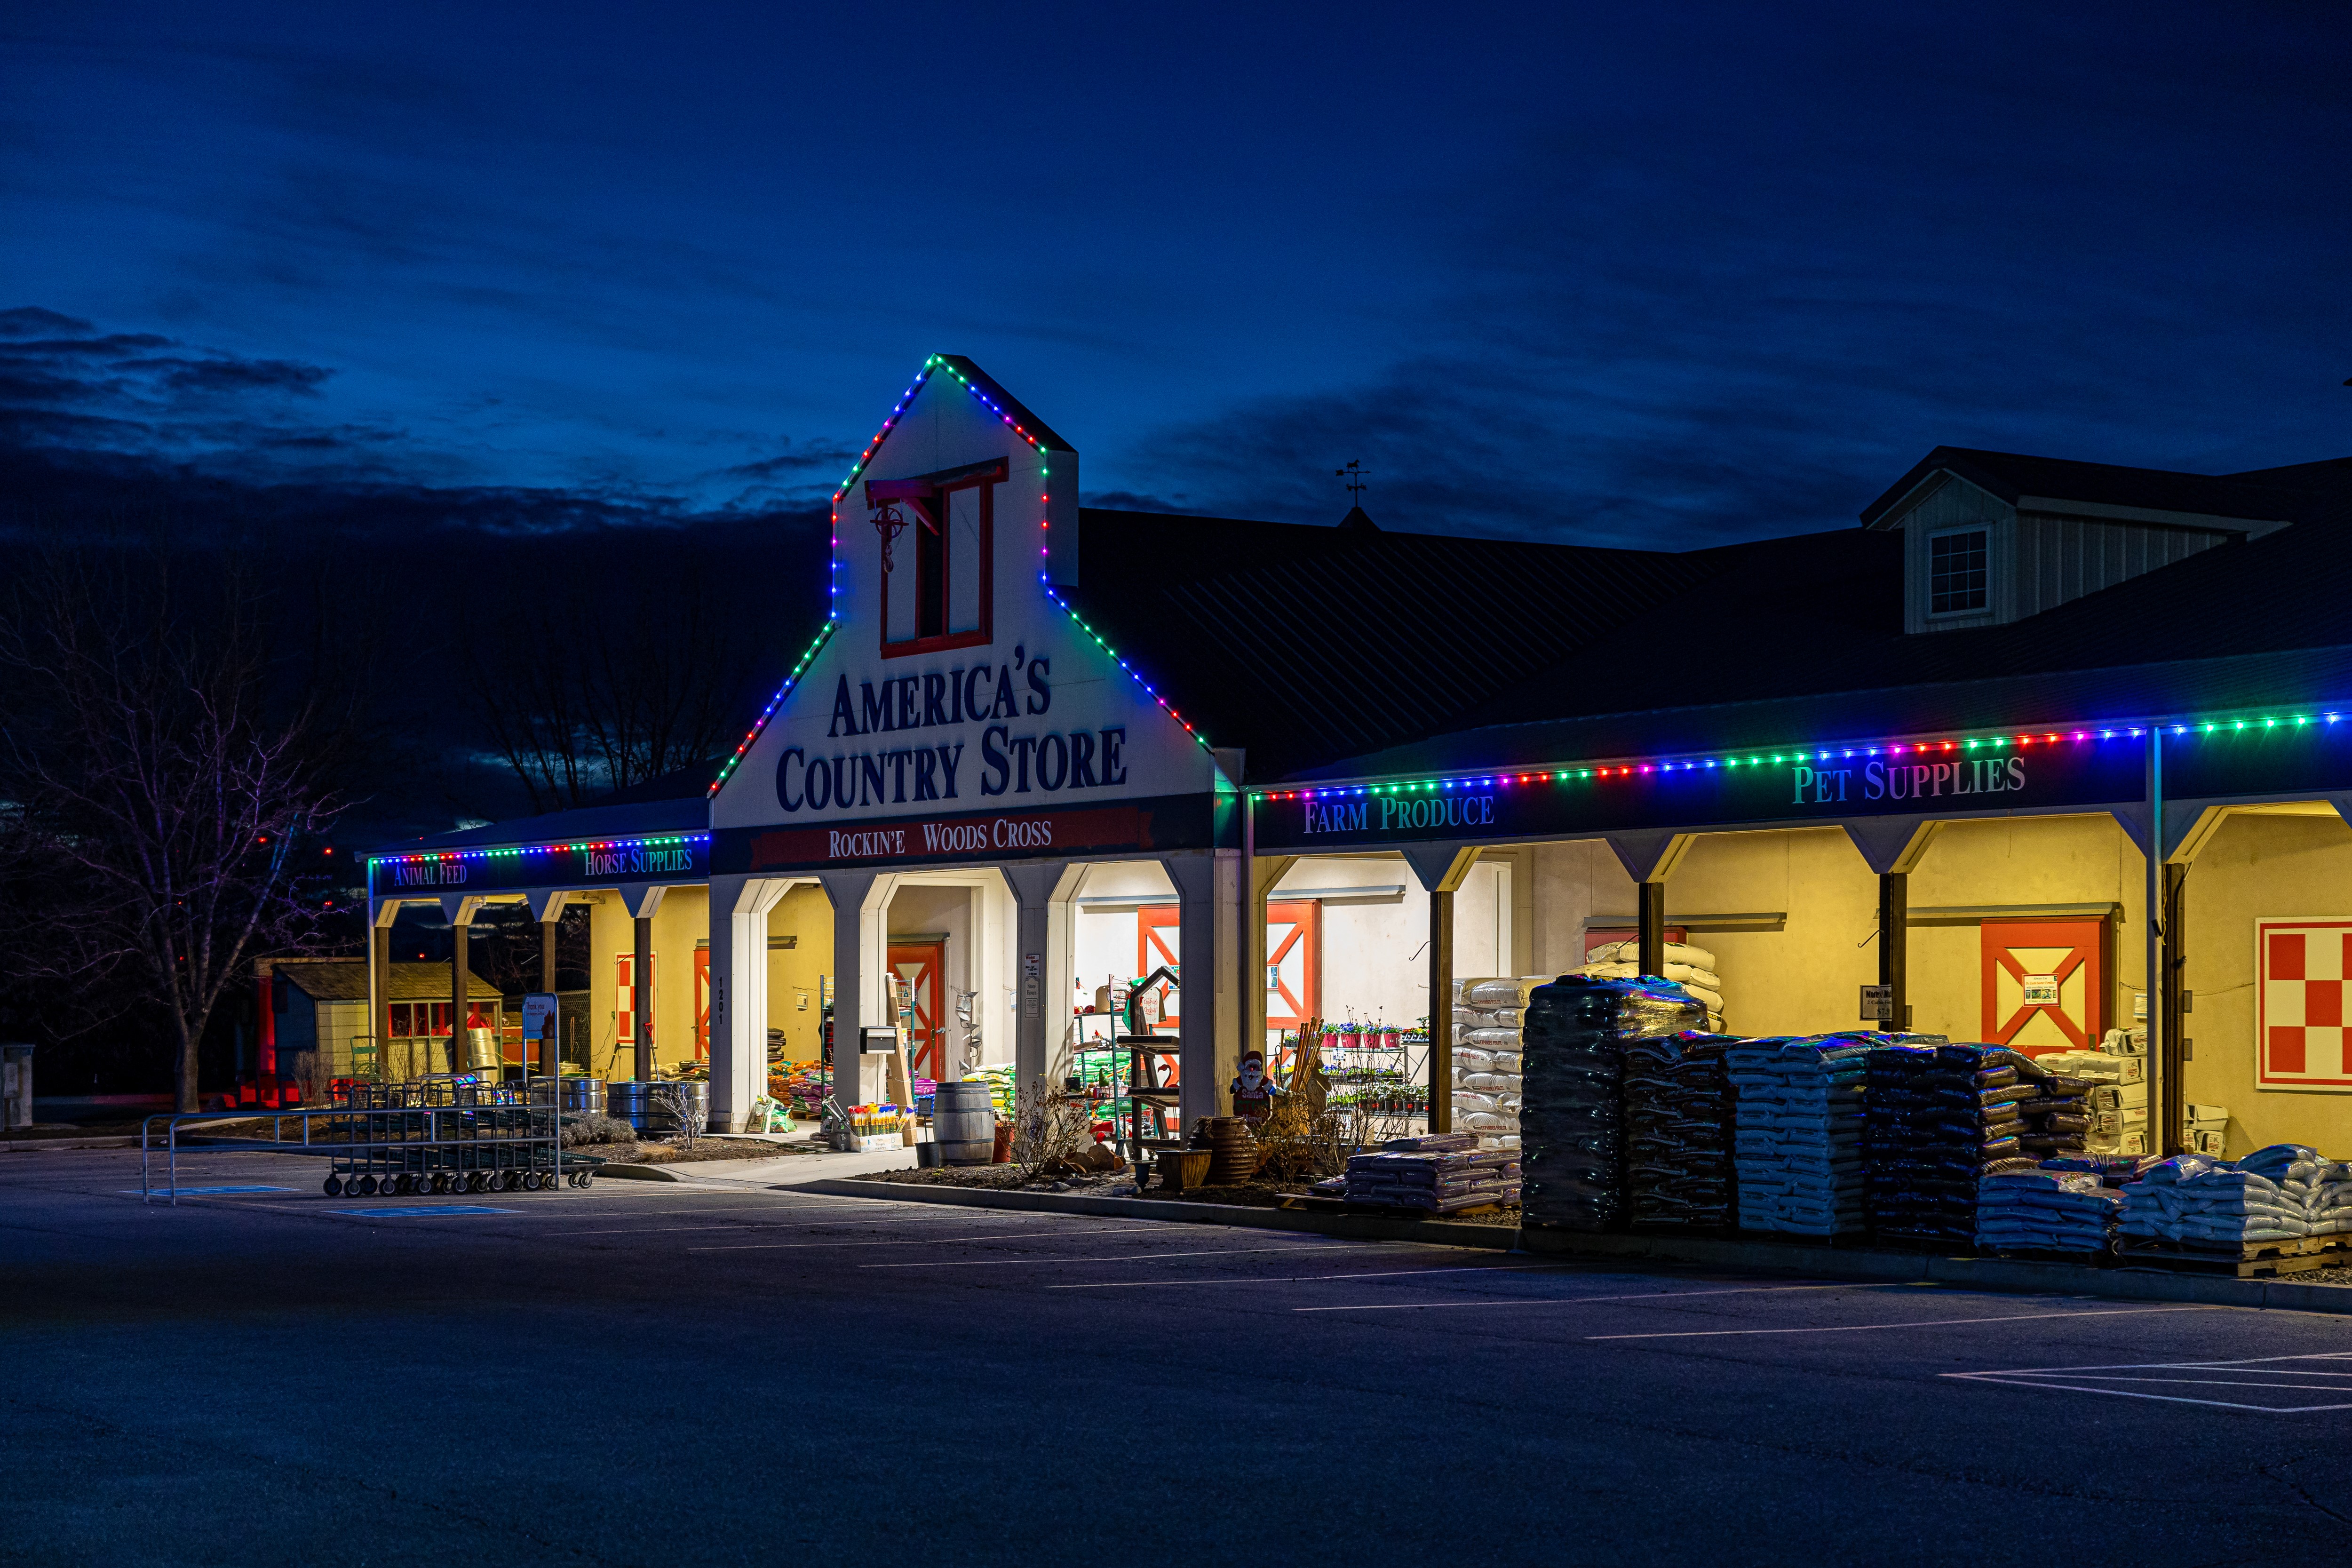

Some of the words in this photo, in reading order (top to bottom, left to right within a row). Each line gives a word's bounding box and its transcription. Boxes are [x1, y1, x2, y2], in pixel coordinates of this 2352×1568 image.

[827, 645, 1051, 738] AMERICA'S
[776, 744, 964, 812] COUNTRY
[981, 725, 1127, 796] STORE
[1792, 766, 1851, 804] PET
[1864, 756, 2026, 800] SUPPLIES
[1303, 801, 1368, 834] FARM
[1380, 796, 1494, 830] PRODUCE
[923, 823, 987, 852] WOODS
[993, 819, 1052, 848] CROSS
[394, 864, 436, 886] ANIMAL
[439, 861, 467, 884] FEED
[585, 852, 627, 876] HORSE
[630, 848, 693, 873] SUPPLIES
[1242, 1089, 1263, 1098] Santa
[1243, 1114, 1262, 1122] Here
